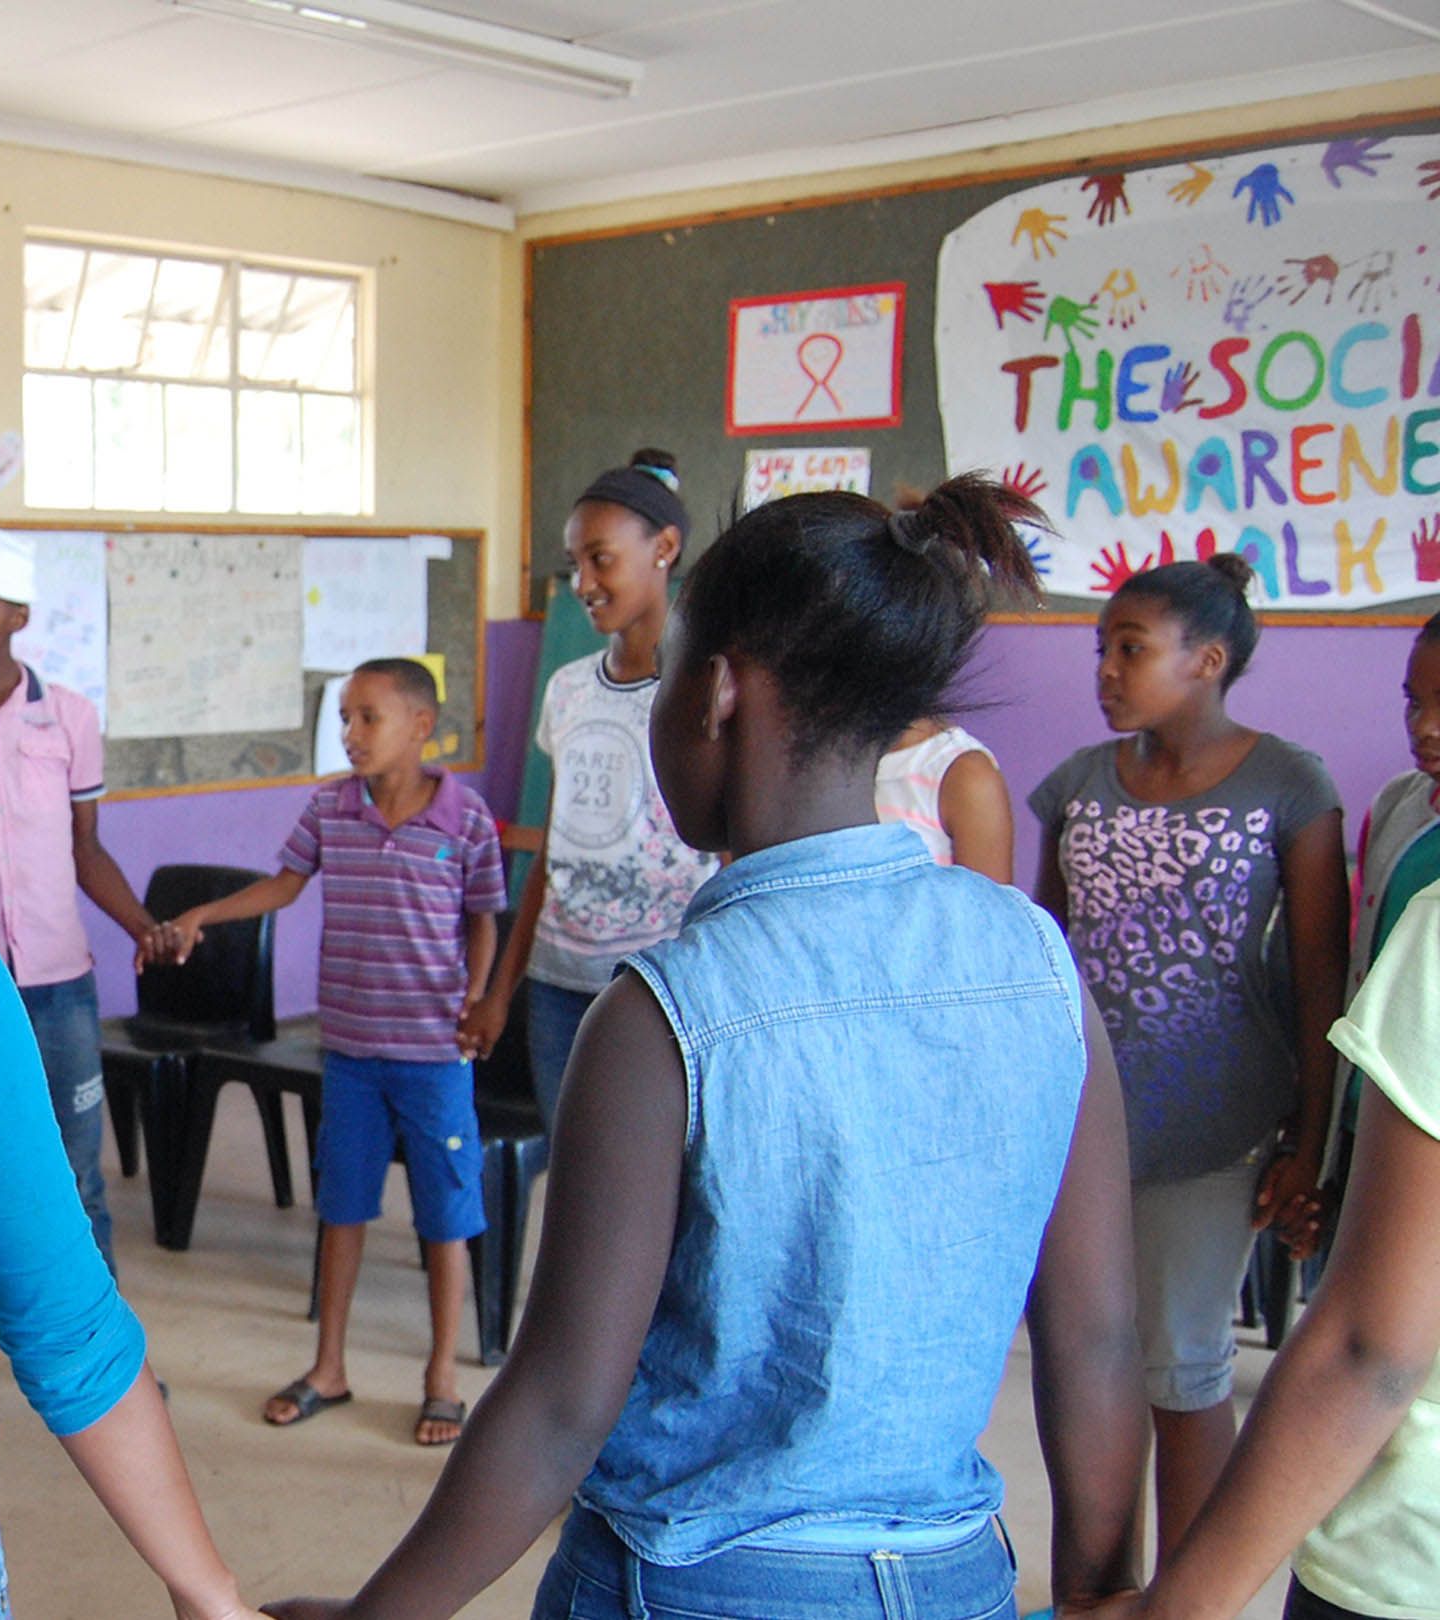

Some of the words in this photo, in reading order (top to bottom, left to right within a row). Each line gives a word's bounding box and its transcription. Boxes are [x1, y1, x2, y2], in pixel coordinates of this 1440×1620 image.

[1001, 344, 1171, 433] THE
[1198, 312, 1440, 419] SOCI
[1065, 408, 1440, 519] AWARENE
[566, 750, 625, 771] PARIS
[570, 773, 611, 807] 23
